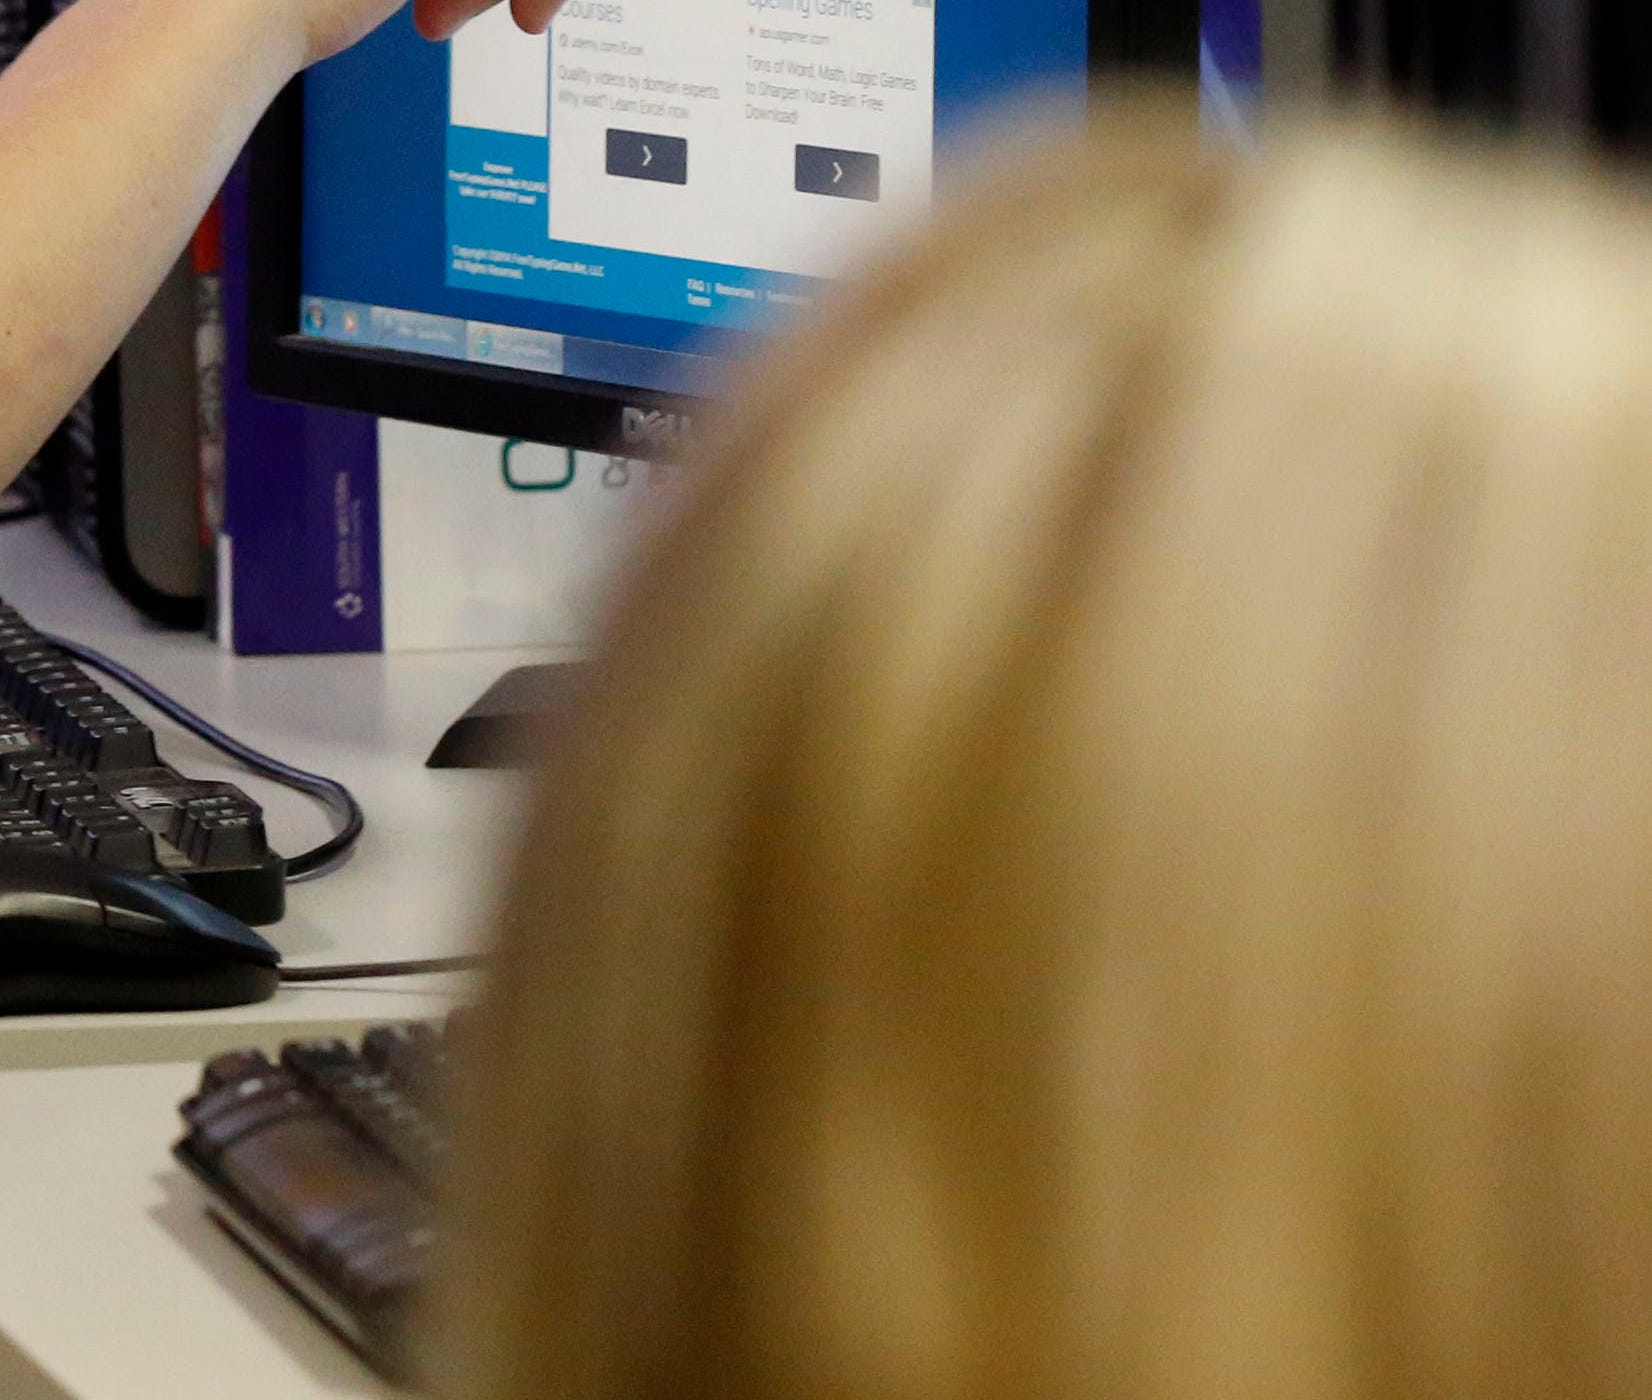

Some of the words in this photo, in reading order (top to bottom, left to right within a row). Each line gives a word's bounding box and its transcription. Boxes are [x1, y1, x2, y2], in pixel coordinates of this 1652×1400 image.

[559, 64, 591, 85] Quality
[596, 69, 625, 87] videos
[628, 73, 639, 92] by
[641, 75, 679, 94] domain
[746, 55, 770, 72] Tons
[773, 57, 784, 74] of
[848, 68, 876, 90] Logic
[879, 72, 916, 91] Games
[558, 88, 578, 107] Why
[609, 96, 636, 112] Learn
[639, 99, 665, 116] Excel
[745, 81, 756, 95] to
[759, 81, 800, 102] Sharpen
[802, 87, 826, 104] Your
[861, 94, 884, 111] Free
